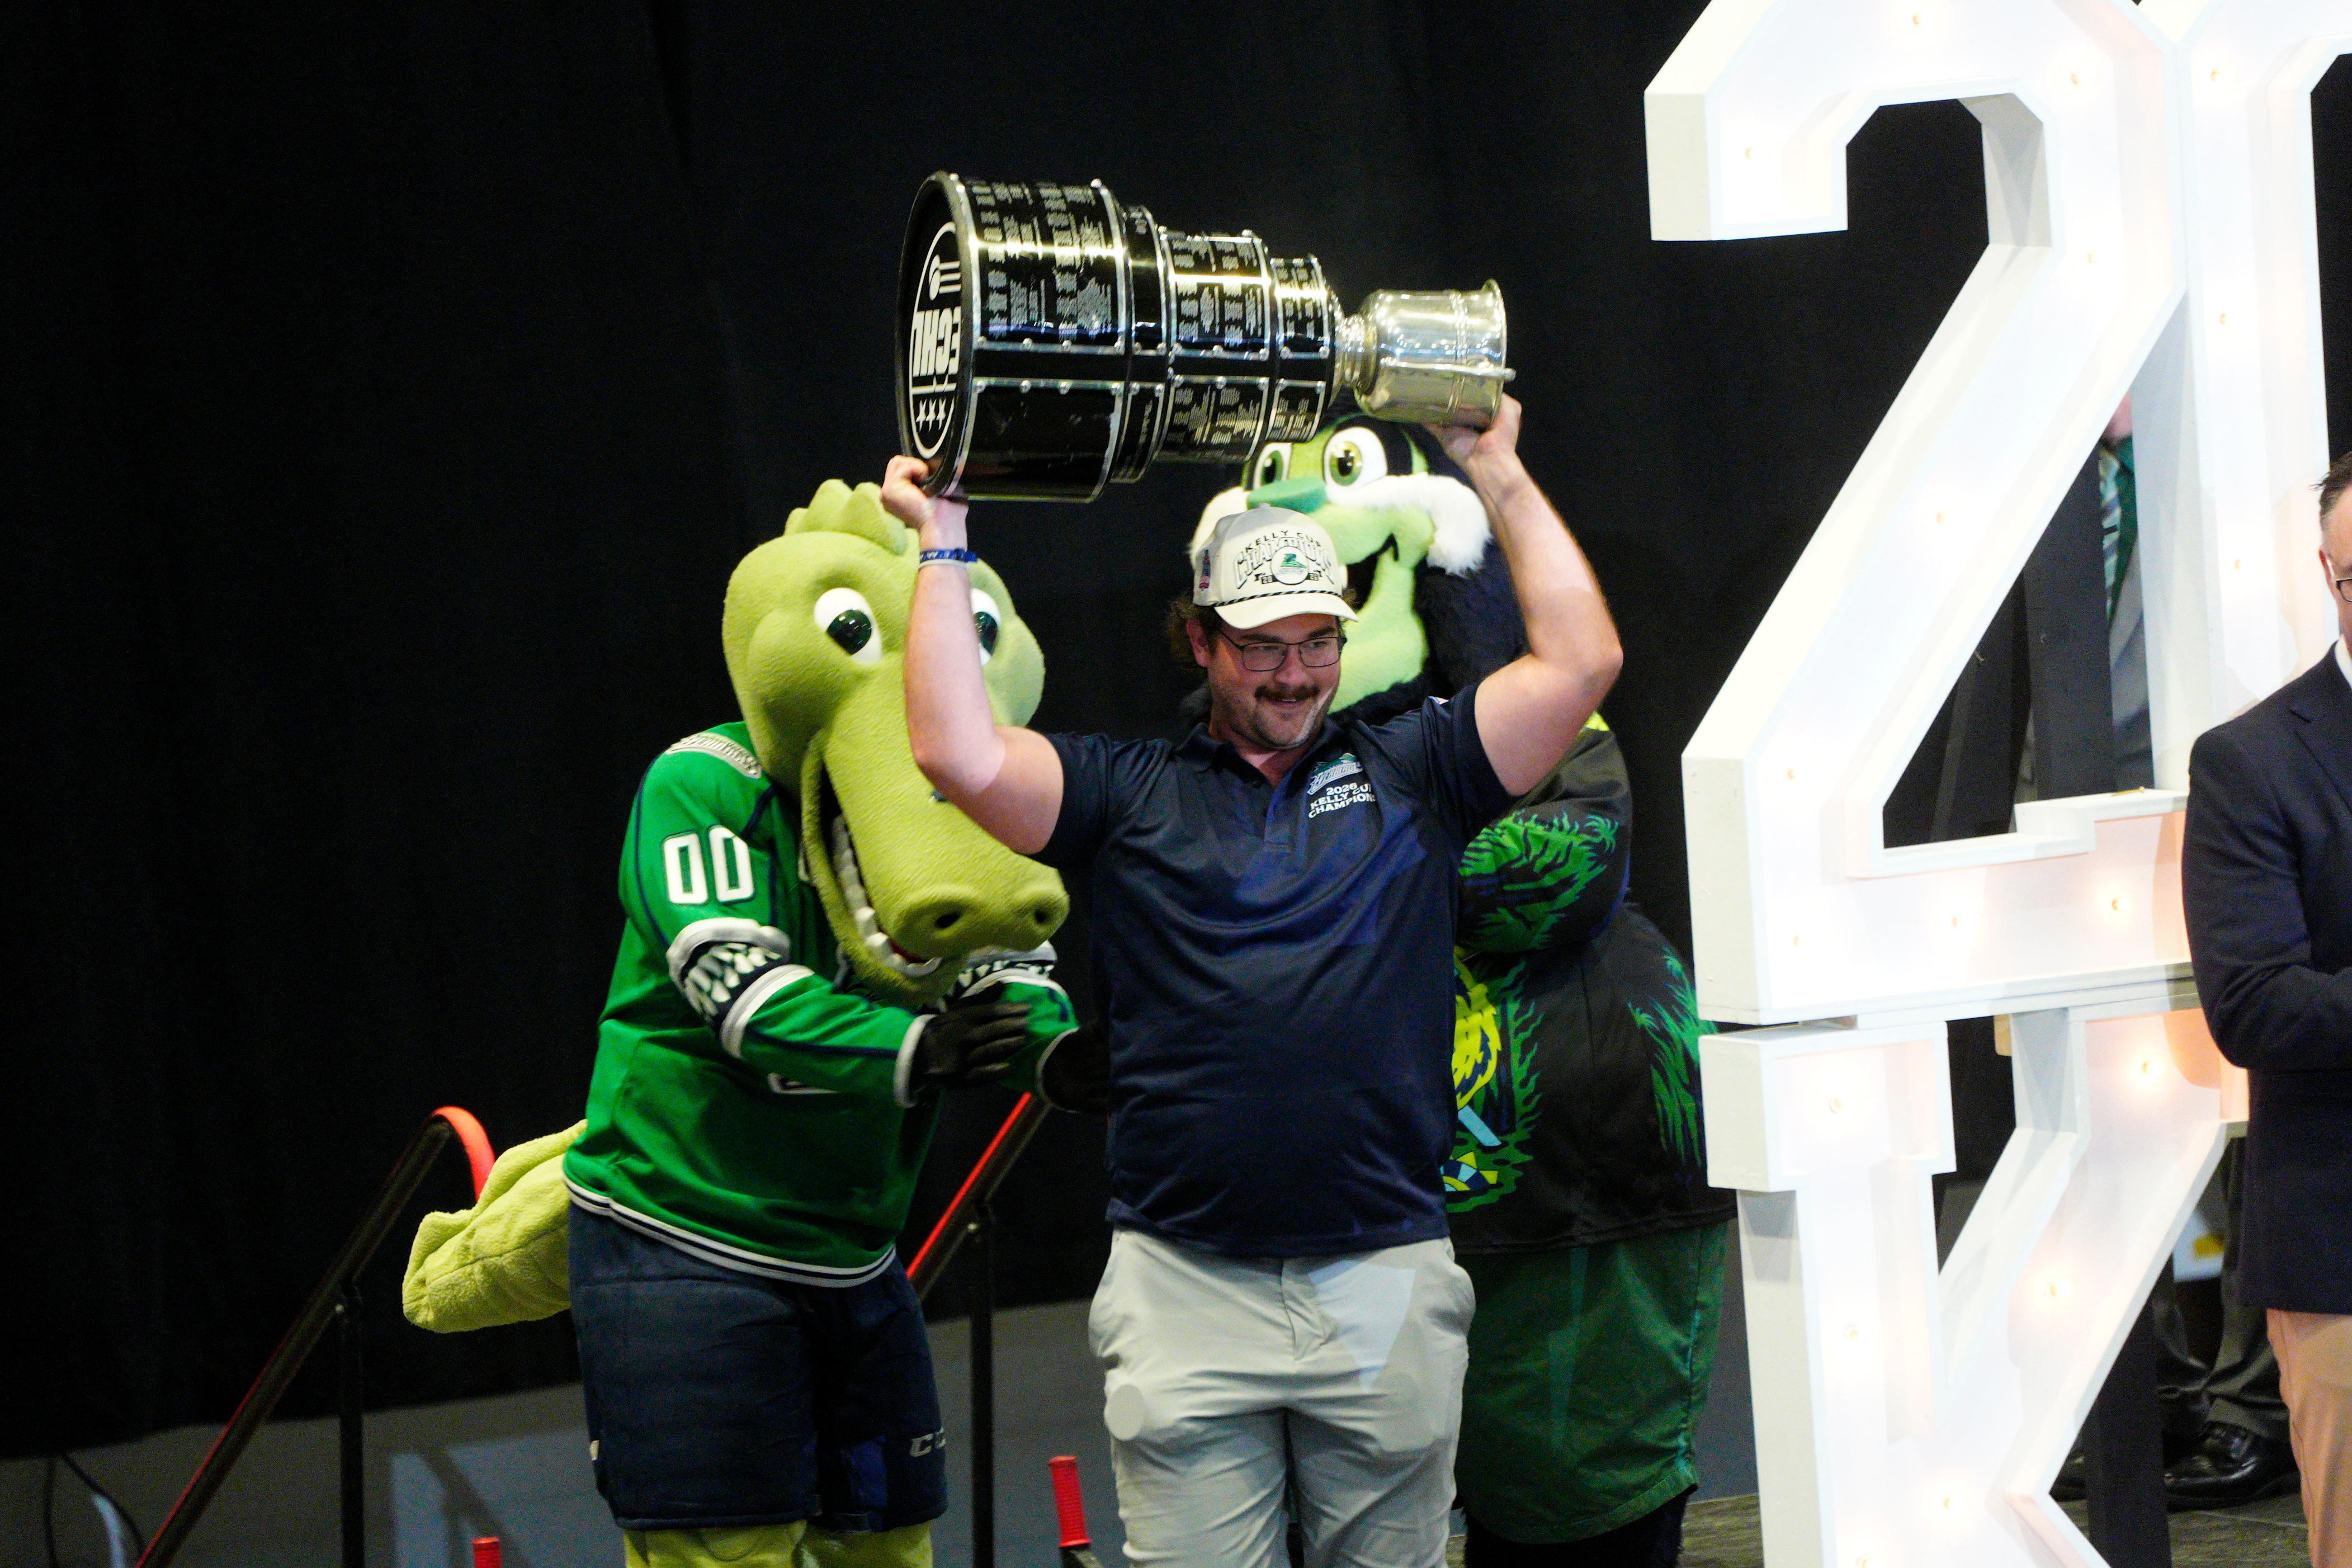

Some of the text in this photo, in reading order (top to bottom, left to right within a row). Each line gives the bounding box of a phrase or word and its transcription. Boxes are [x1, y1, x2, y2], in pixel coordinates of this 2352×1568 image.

[912, 306, 961, 377] ECHL
[1245, 530, 1288, 552] KELLY
[1326, 782, 1357, 795] 2026
[1310, 792, 1349, 810] KELLY
[662, 824, 755, 905] 00
